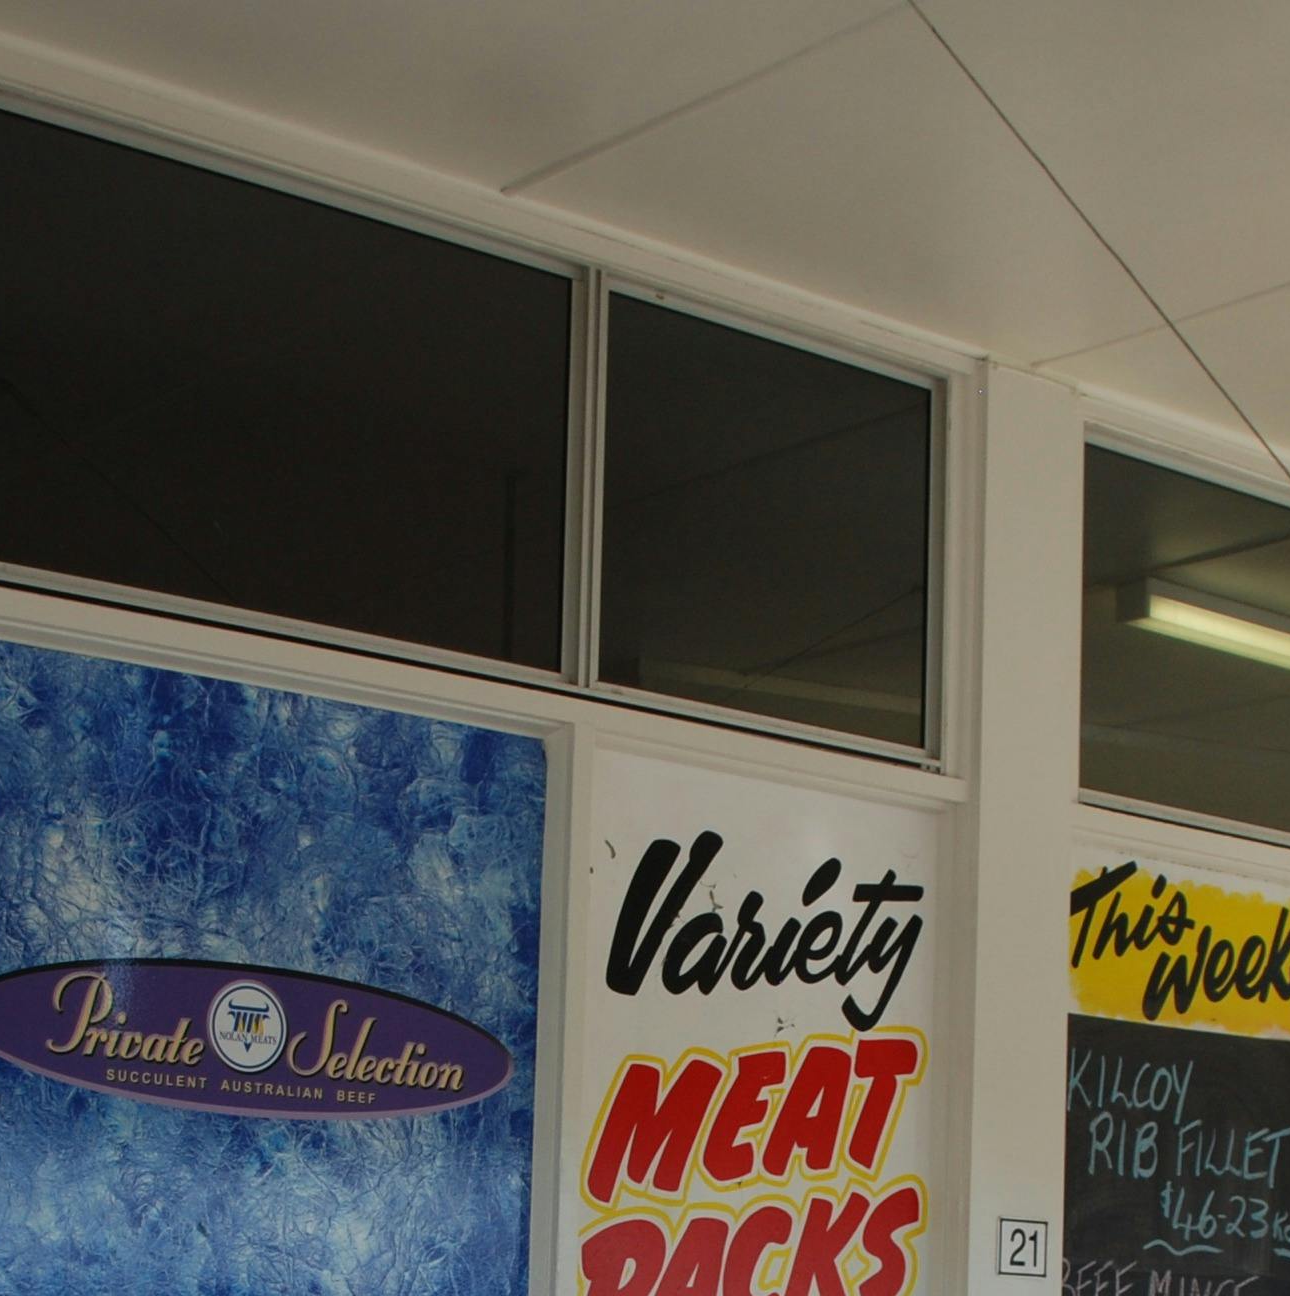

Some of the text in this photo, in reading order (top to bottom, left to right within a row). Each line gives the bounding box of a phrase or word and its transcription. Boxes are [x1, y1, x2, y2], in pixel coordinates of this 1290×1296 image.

[605, 829, 925, 1032] Variety
[1070, 860, 1195, 969] This
[45, 969, 465, 1093] Private Selection
[106, 1067, 378, 1105] SUCCULENT AUSTRALIAN BEEF
[586, 1037, 919, 1203] MEAT
[1067, 1046, 1194, 1126] KILCOY
[1088, 1111, 1159, 1180] RIB
[1008, 1234, 1039, 1269] 21
